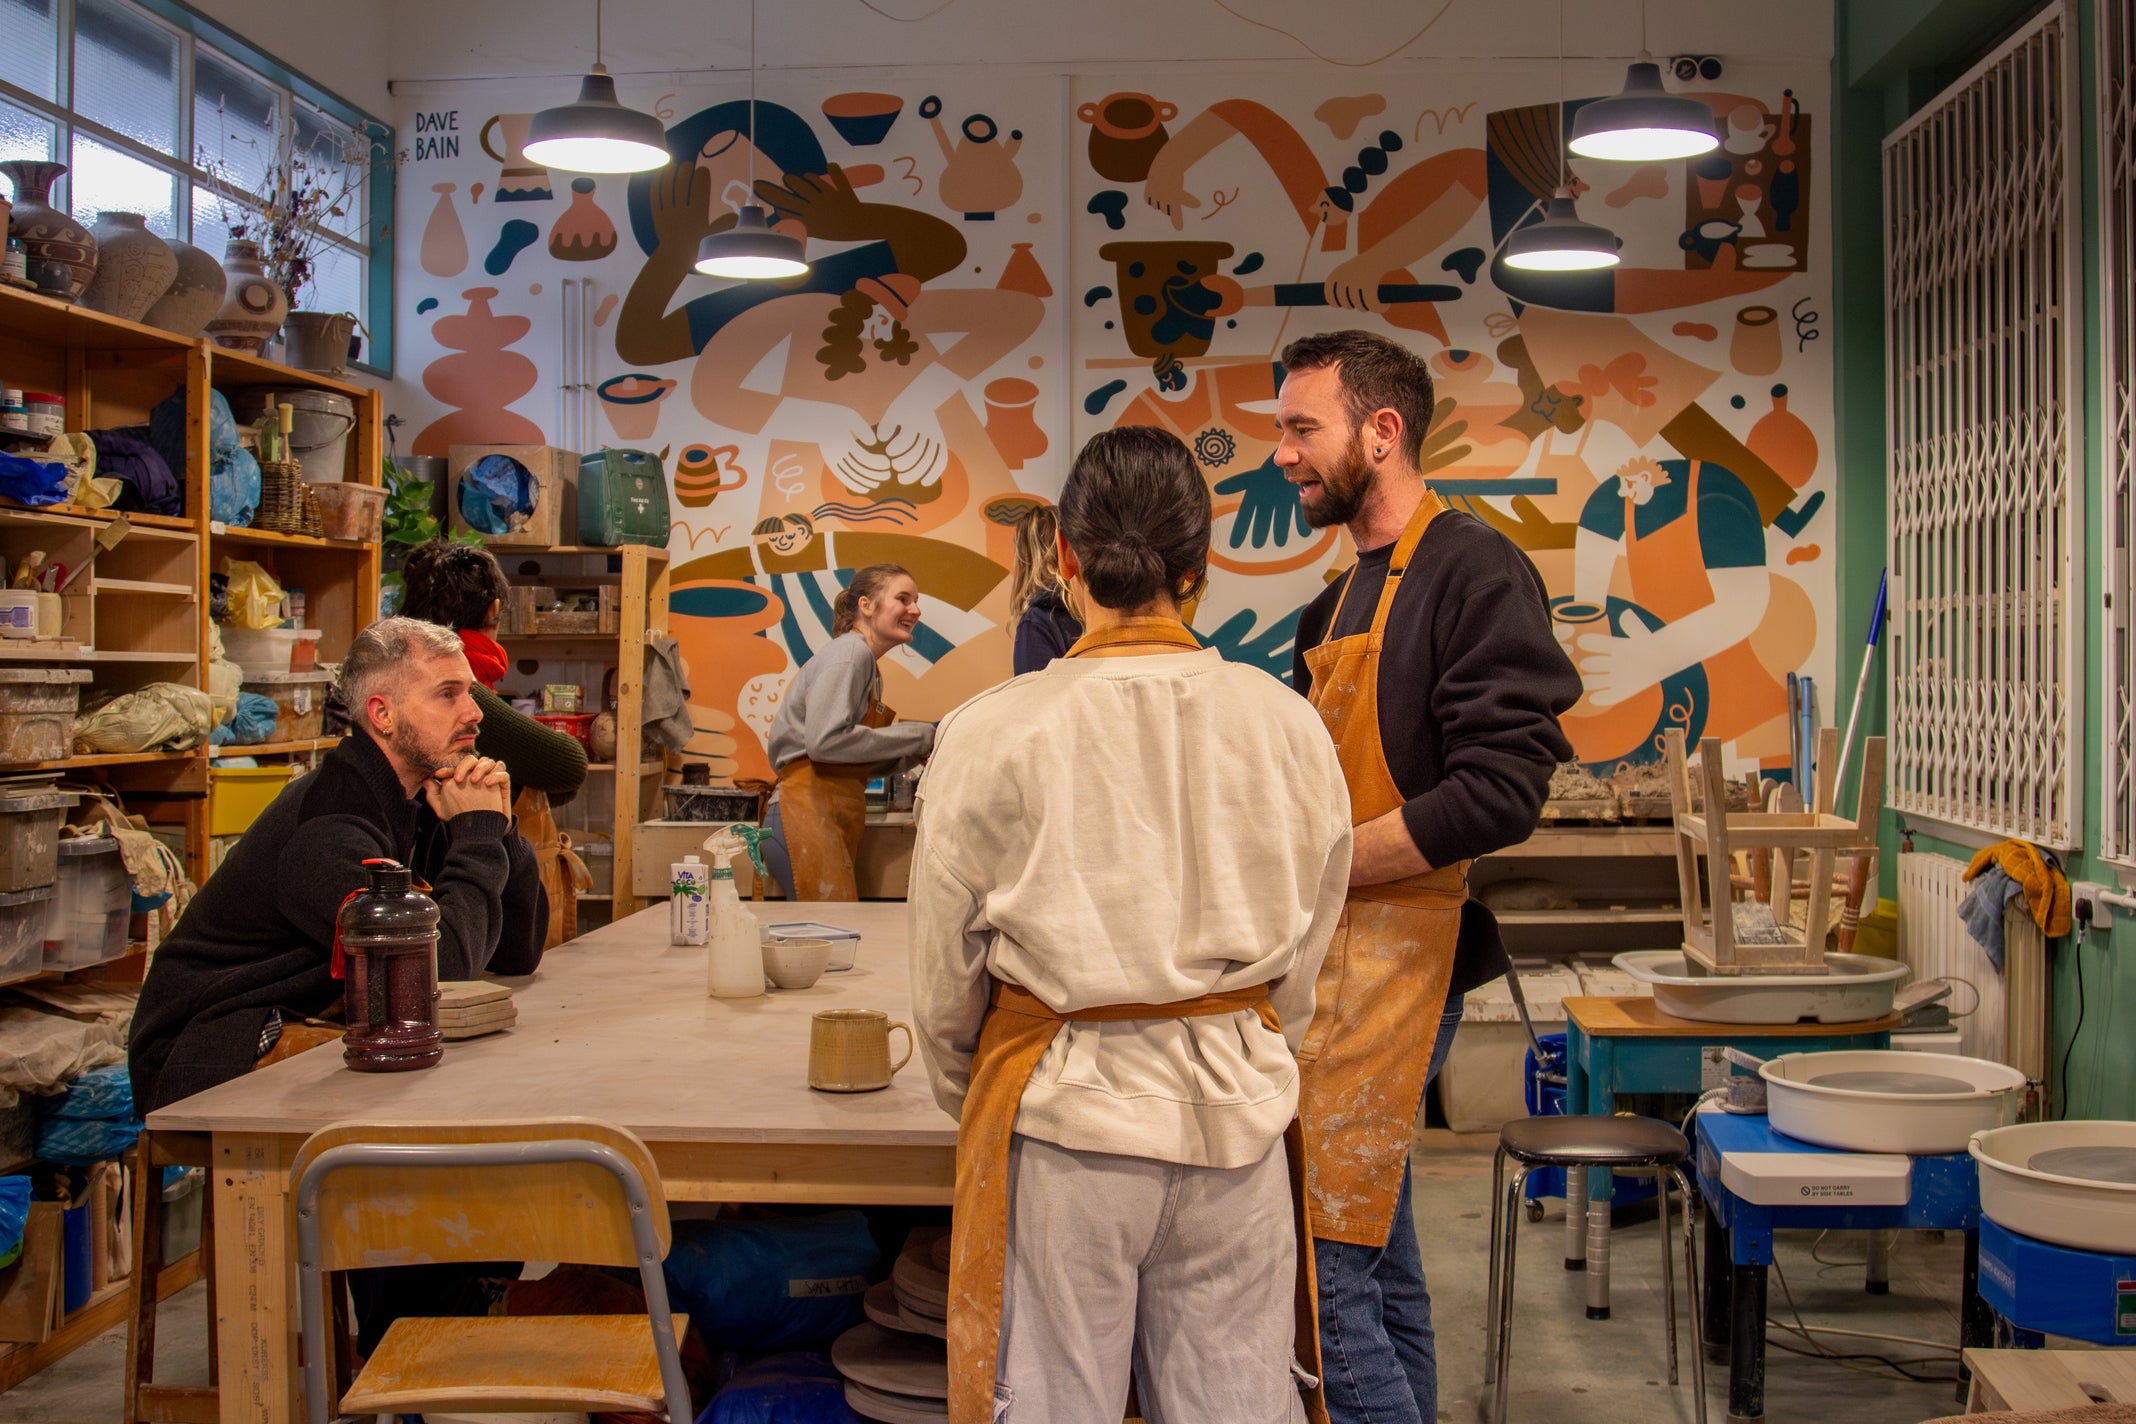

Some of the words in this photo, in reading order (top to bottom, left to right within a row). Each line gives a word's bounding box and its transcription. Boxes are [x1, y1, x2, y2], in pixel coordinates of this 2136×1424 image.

[416, 111, 458, 132] DAVE
[416, 136, 458, 161] BAIN
[677, 871, 694, 879] VITA
[257, 1227, 266, 1266] GRADED
